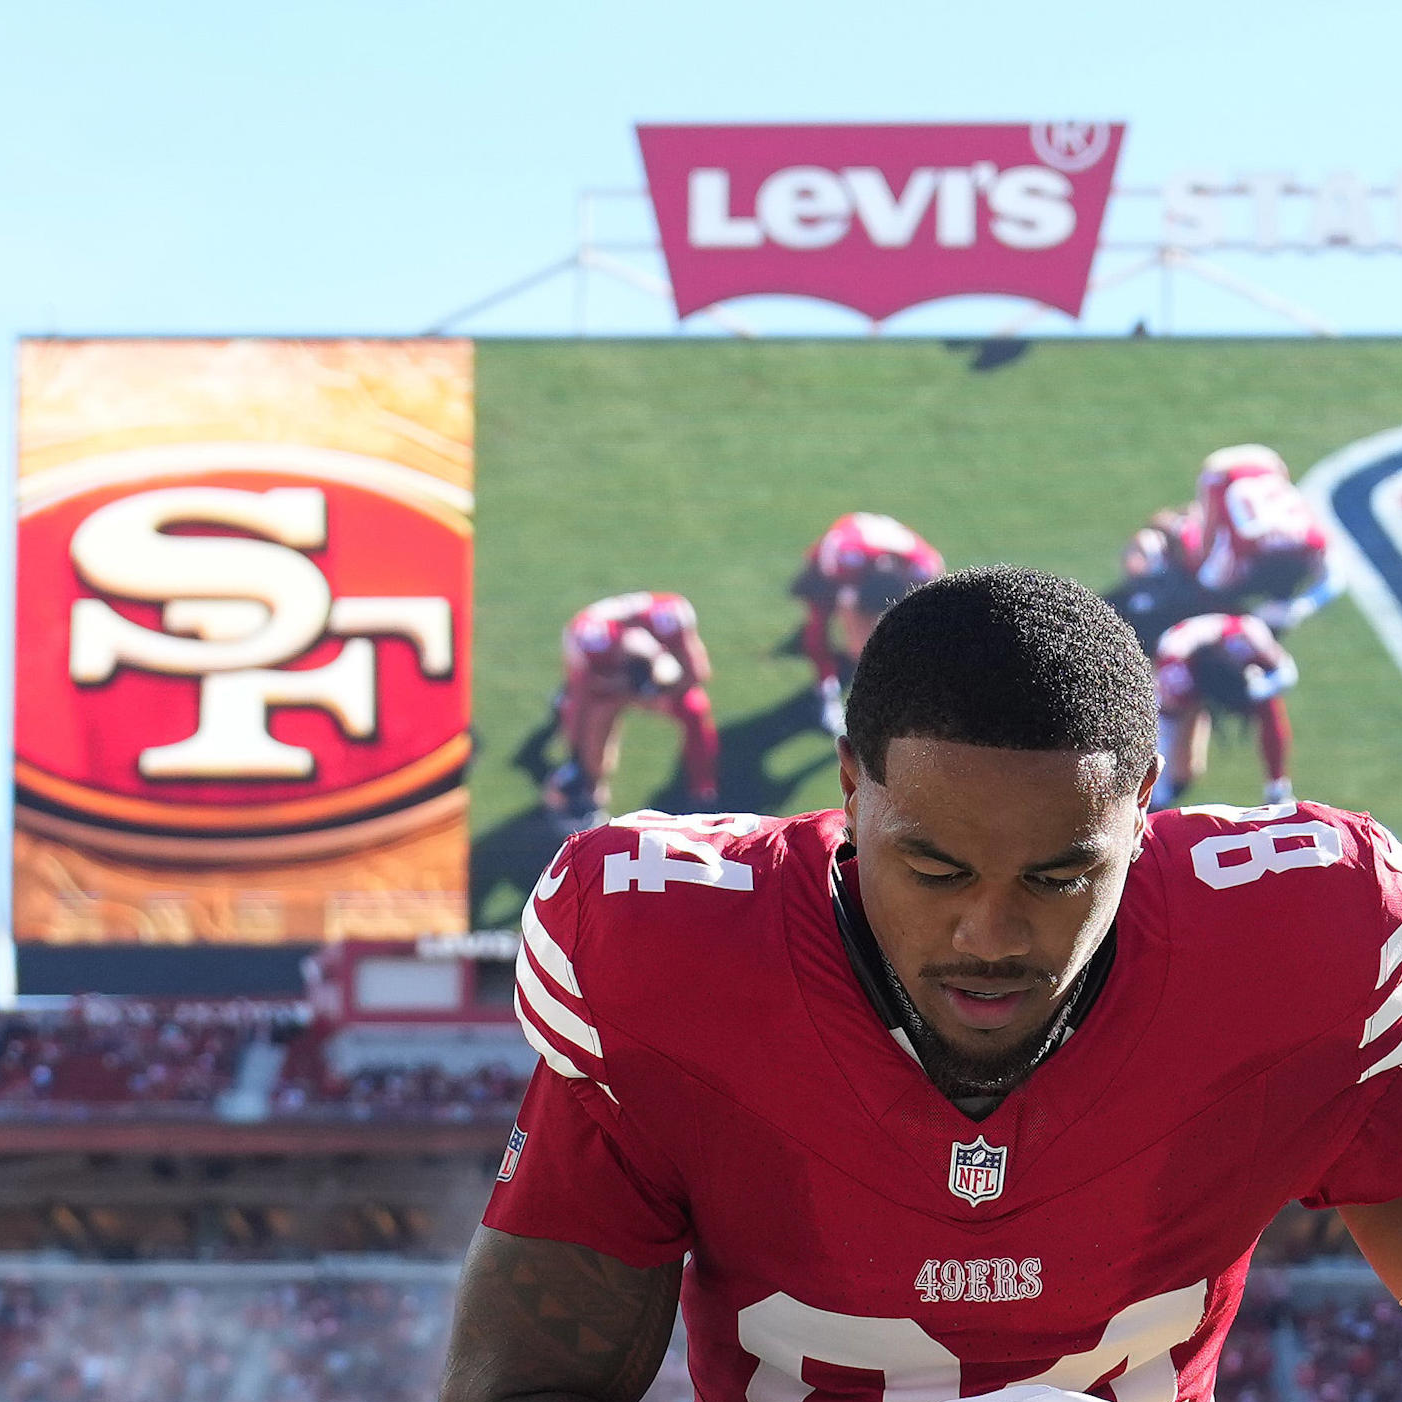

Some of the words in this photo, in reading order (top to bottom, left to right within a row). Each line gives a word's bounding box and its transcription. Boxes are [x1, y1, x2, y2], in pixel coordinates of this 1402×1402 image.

[69, 486, 454, 781] SF
[957, 1166, 995, 1194] NFL
[913, 1257, 1044, 1303] 49ERS
